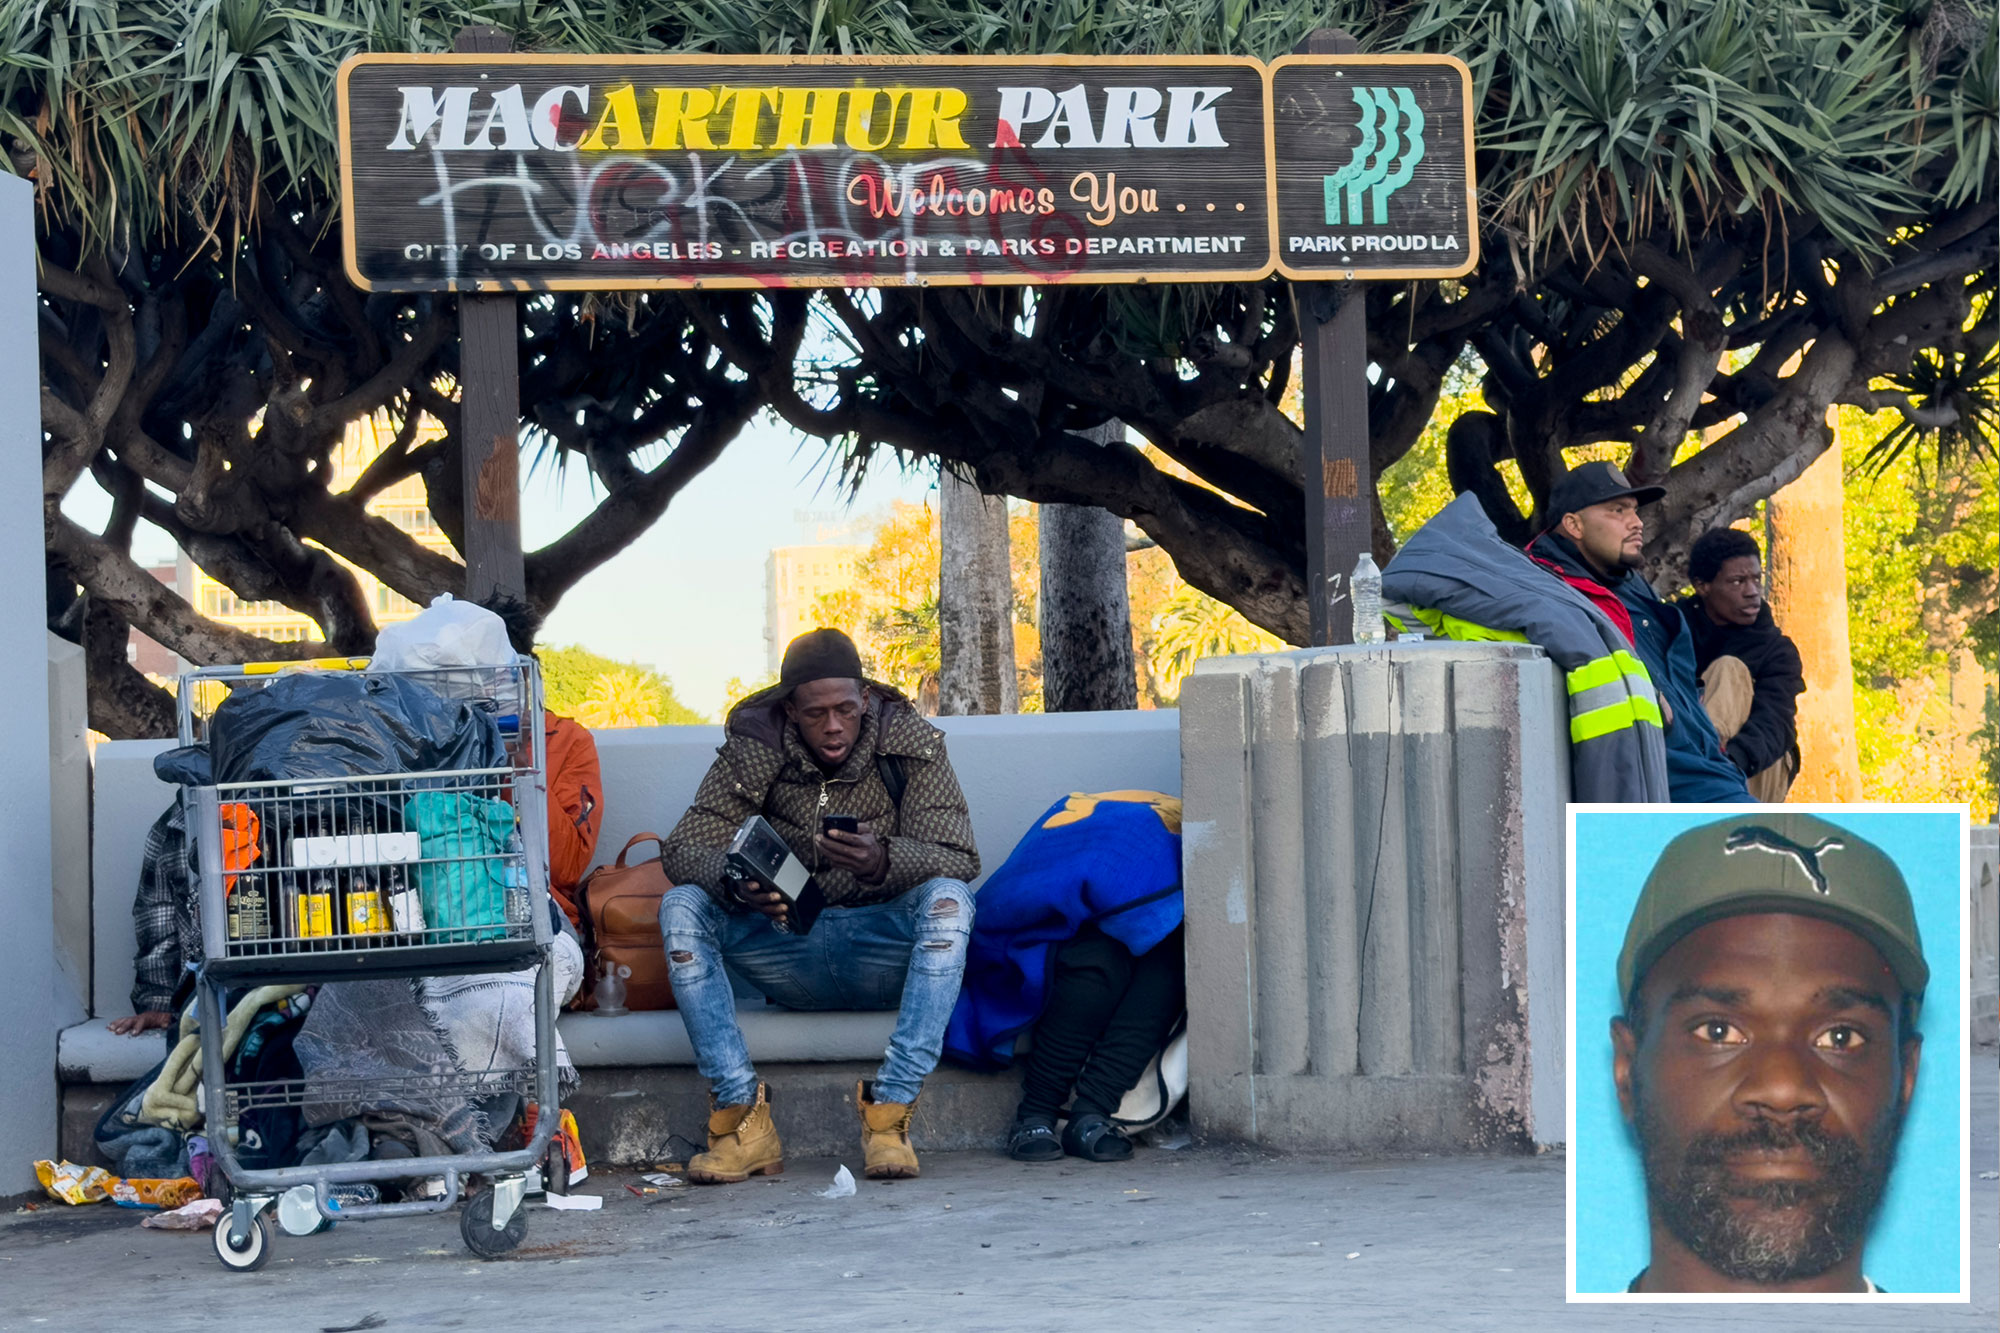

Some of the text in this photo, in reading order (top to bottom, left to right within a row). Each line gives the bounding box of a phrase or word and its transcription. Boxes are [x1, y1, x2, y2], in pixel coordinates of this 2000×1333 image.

[386, 83, 969, 150] MACARTHUR
[989, 84, 1232, 149] PARK
[847, 173, 1055, 219] Welcomes
[1069, 171, 1159, 226] You
[480, 243, 516, 260] OF
[525, 242, 583, 261] LOS
[591, 241, 723, 260] ANGELES
[750, 240, 929, 259] RECREATION
[938, 239, 957, 257] &
[965, 237, 1055, 257] PARKS
[1064, 237, 1246, 256] DEPARTMENT
[1288, 235, 1459, 251] PARK PROUD LA
